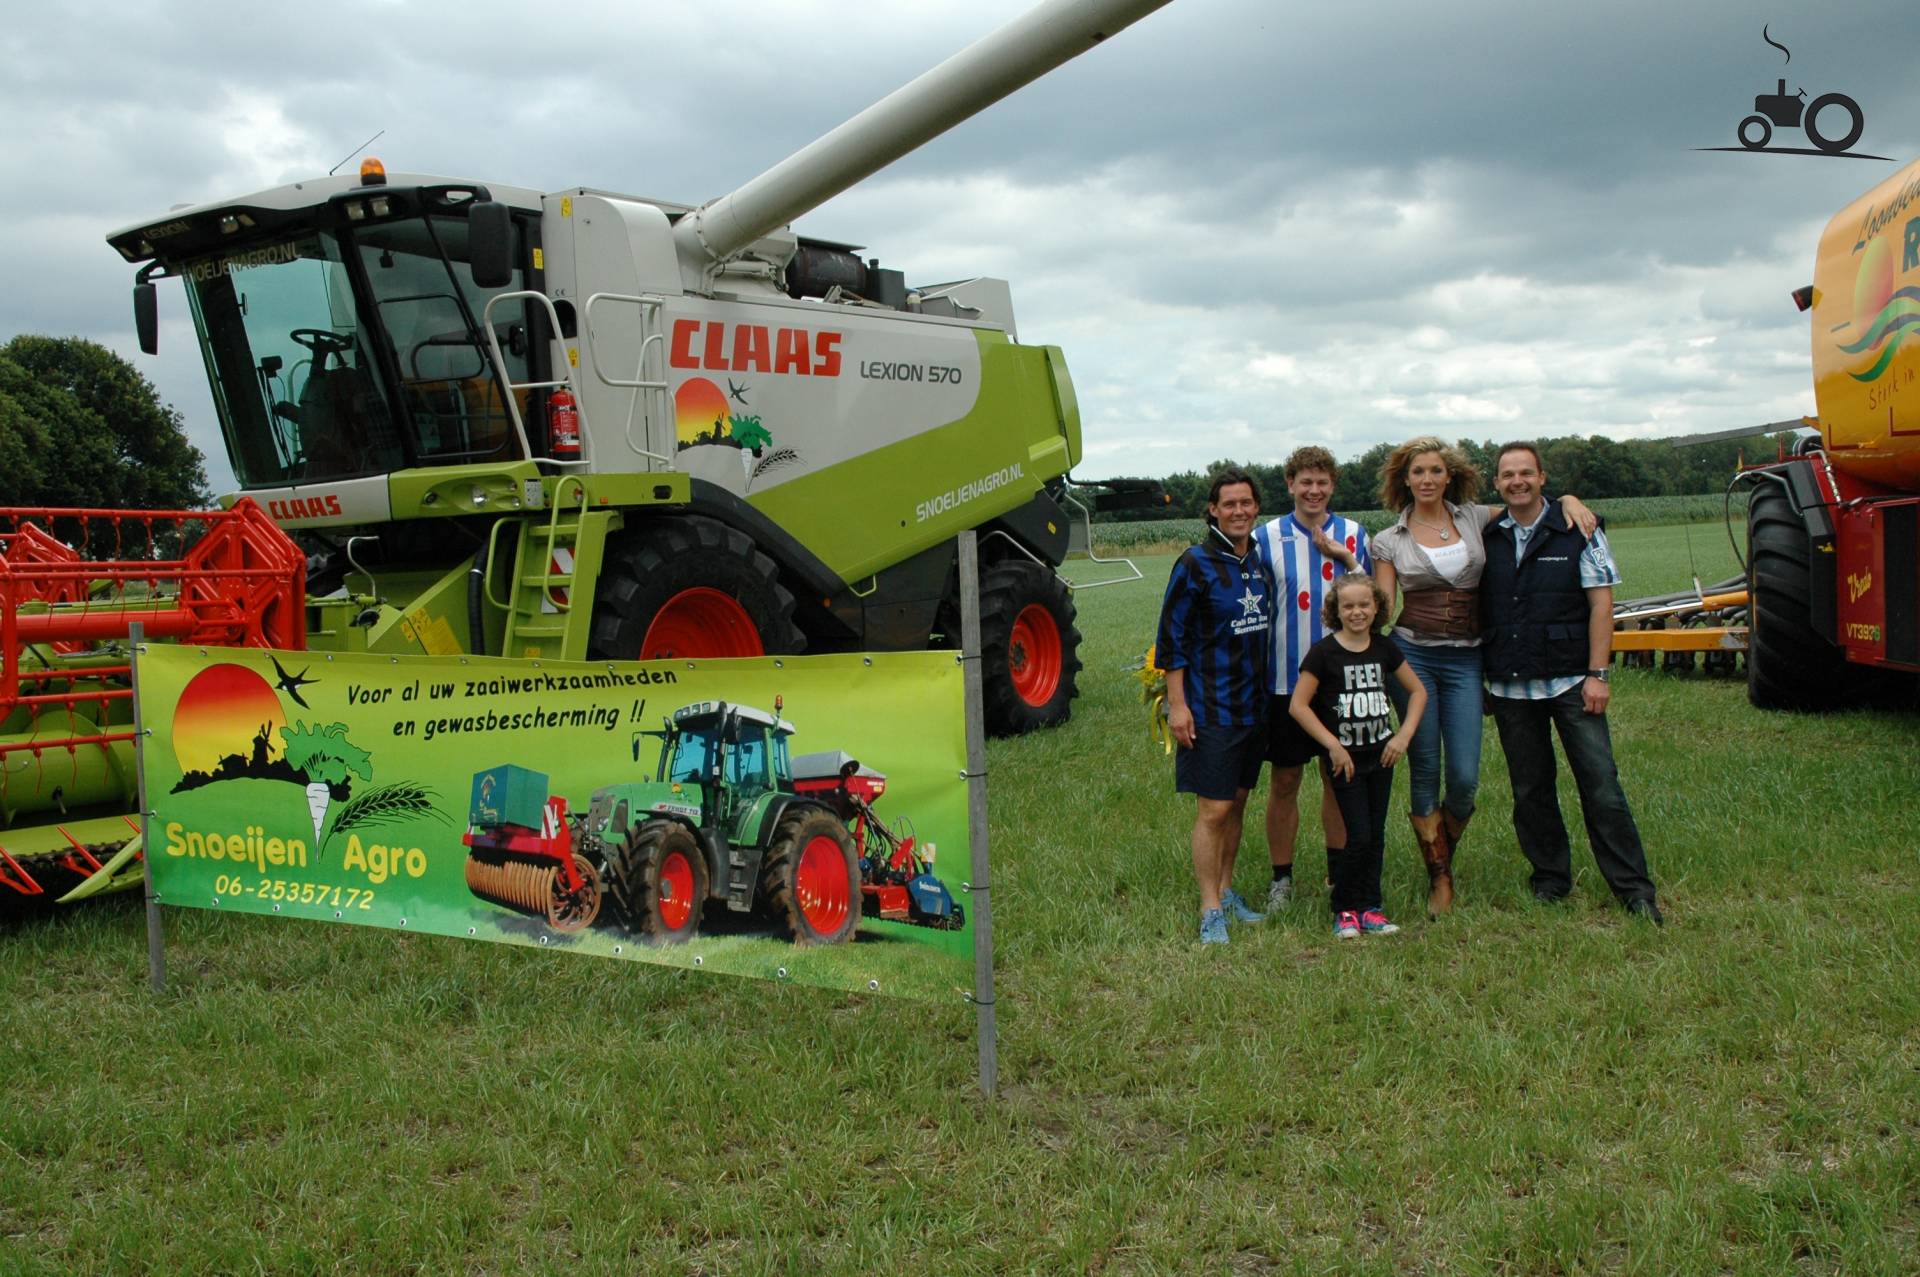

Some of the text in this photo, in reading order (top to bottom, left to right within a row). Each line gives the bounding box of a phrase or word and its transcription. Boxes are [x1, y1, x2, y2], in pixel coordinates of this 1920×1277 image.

[669, 318, 842, 377] CLAAS
[860, 360, 962, 385] LEXION 570
[268, 495, 342, 520] CLAAS
[915, 462, 1025, 523] SNOEIJENAGRO.NL
[348, 668, 678, 706] Voor al uw zaaiwerkzaamheden
[1343, 663, 1384, 690] FEEL
[393, 718, 416, 737] en
[424, 703, 620, 741] gewasbescherming
[1338, 691, 1390, 718] YOUR
[166, 821, 428, 884] Snoeijen Agro
[215, 874, 375, 911] 06-25357172
